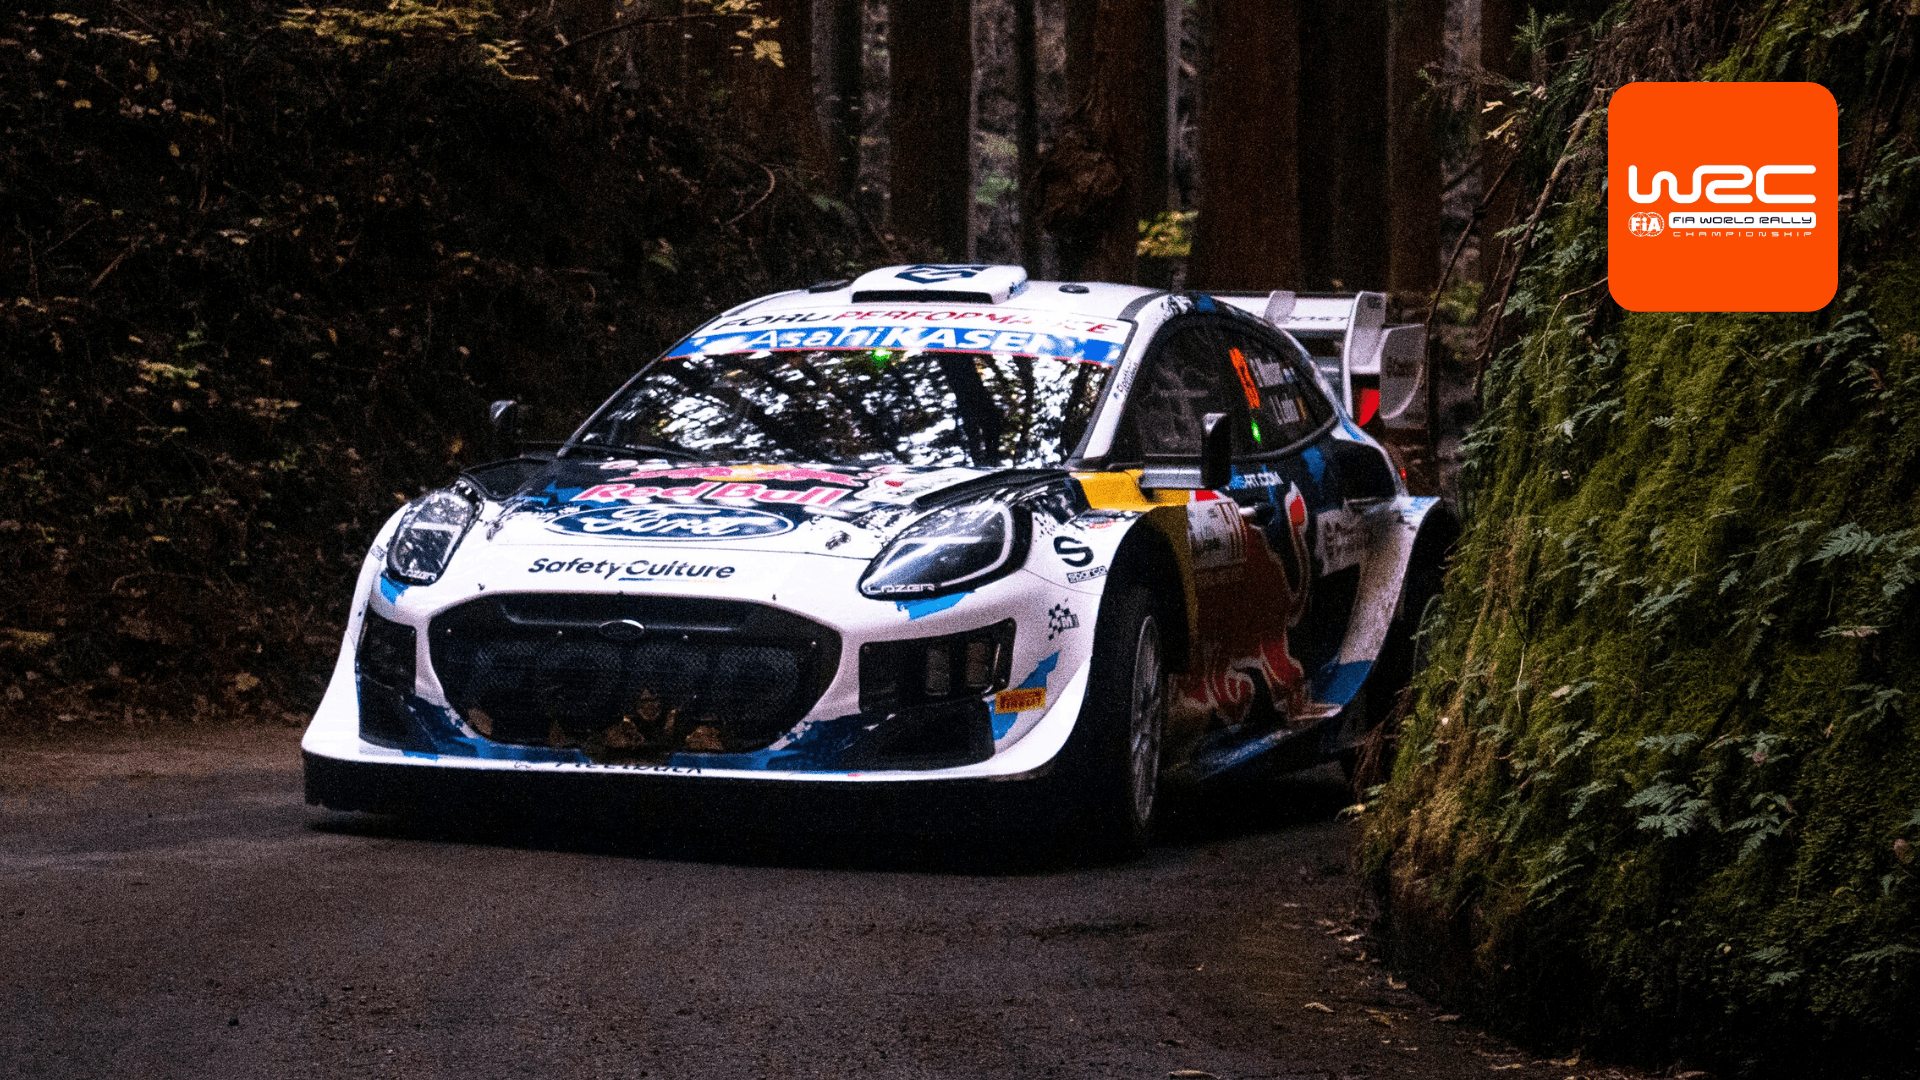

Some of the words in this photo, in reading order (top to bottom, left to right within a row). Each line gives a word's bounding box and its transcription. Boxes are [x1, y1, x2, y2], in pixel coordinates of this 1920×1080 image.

[571, 481, 717, 502] Red
[702, 482, 853, 506] Bull
[582, 504, 776, 536] Ford
[527, 557, 736, 580] SafetyCulture
